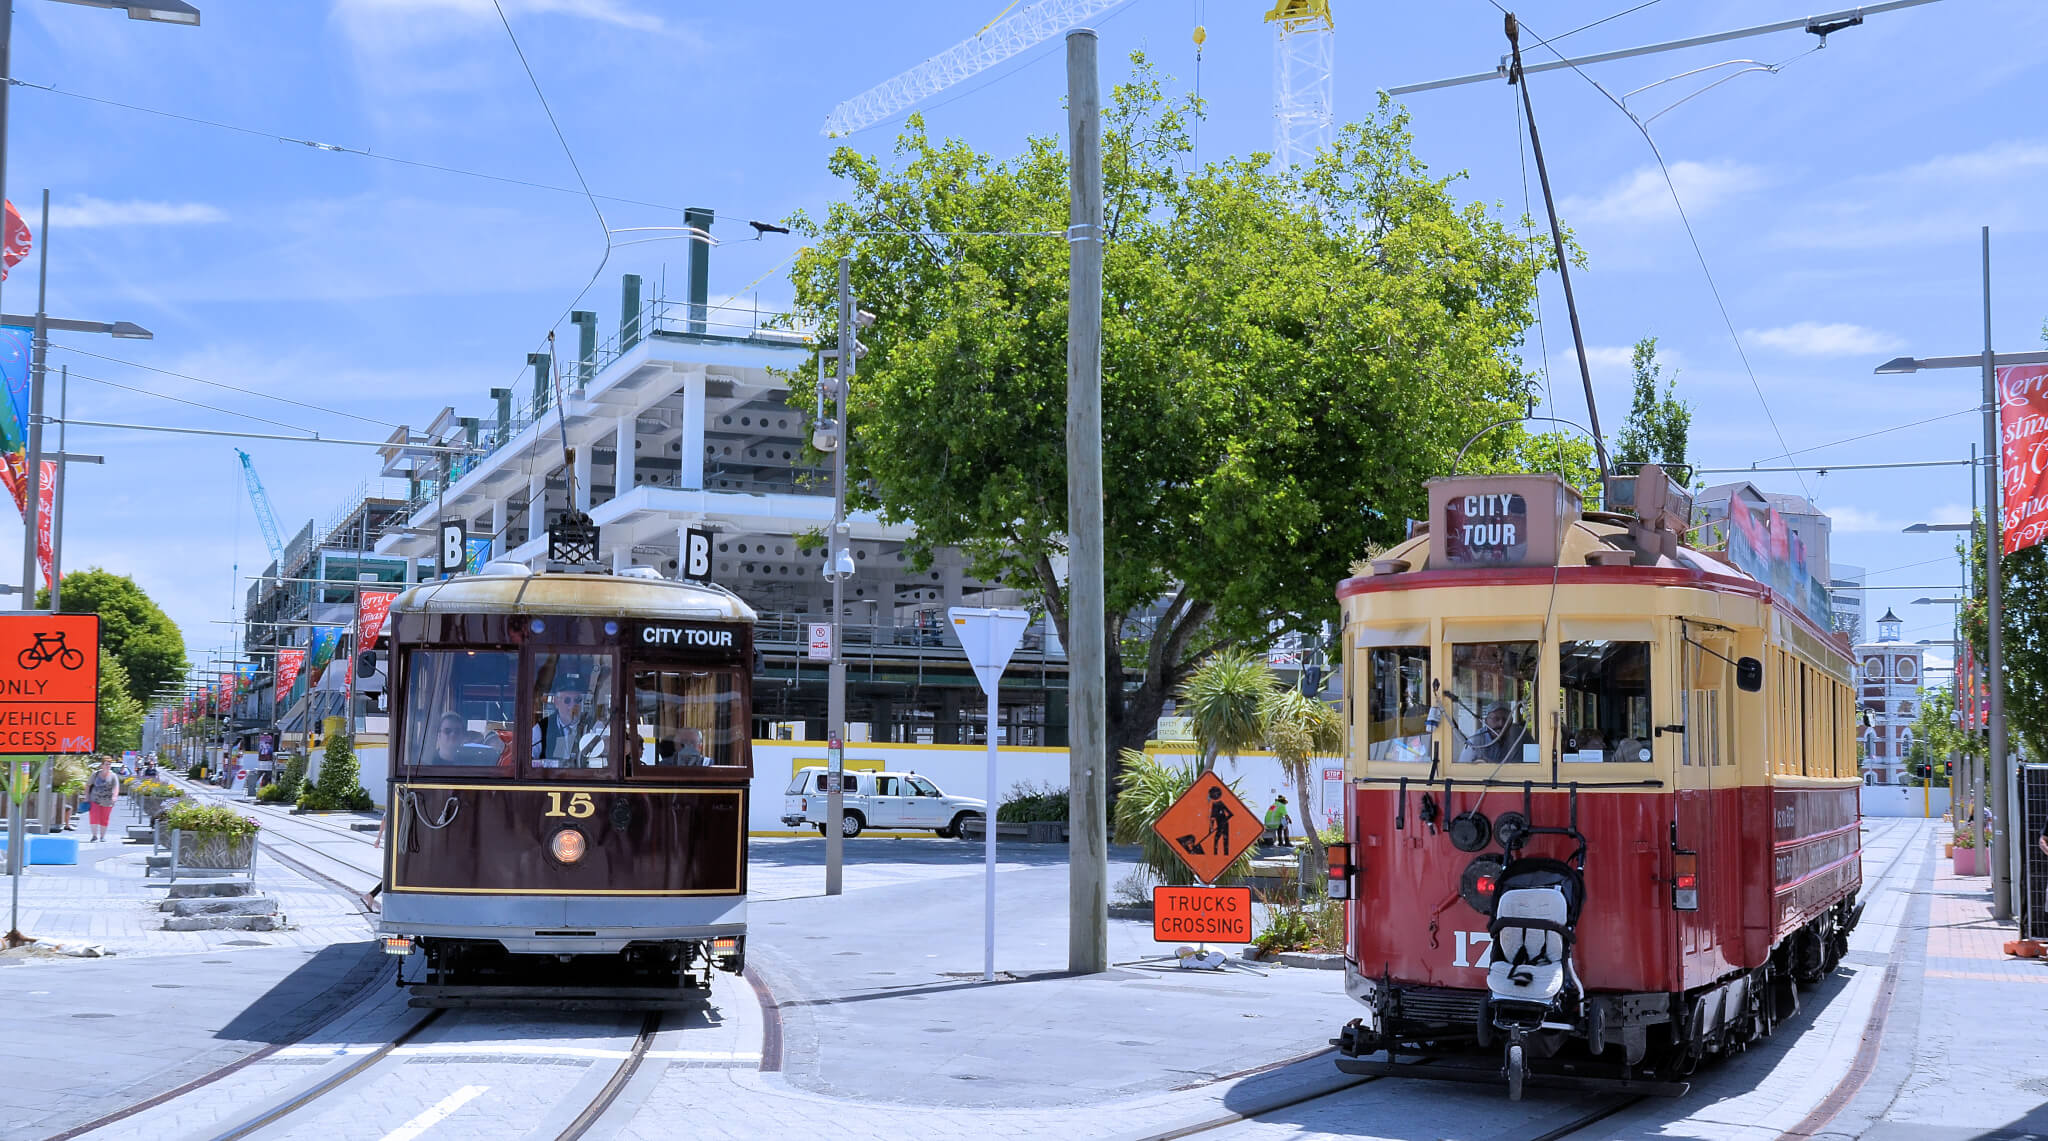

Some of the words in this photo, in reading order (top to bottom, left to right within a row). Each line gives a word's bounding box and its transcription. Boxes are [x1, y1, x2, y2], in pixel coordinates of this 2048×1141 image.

[1464, 493, 1513, 517] CITY
[1463, 523, 1516, 546] TOUR
[444, 526, 463, 568] B
[689, 534, 709, 576] B
[642, 627, 682, 644] CITY
[684, 629, 733, 647] TOUR
[545, 792, 596, 818] 15
[1168, 895, 1237, 912] TRUCKS
[1161, 917, 1244, 934] CROSSING
[1452, 930, 1494, 968] 17
